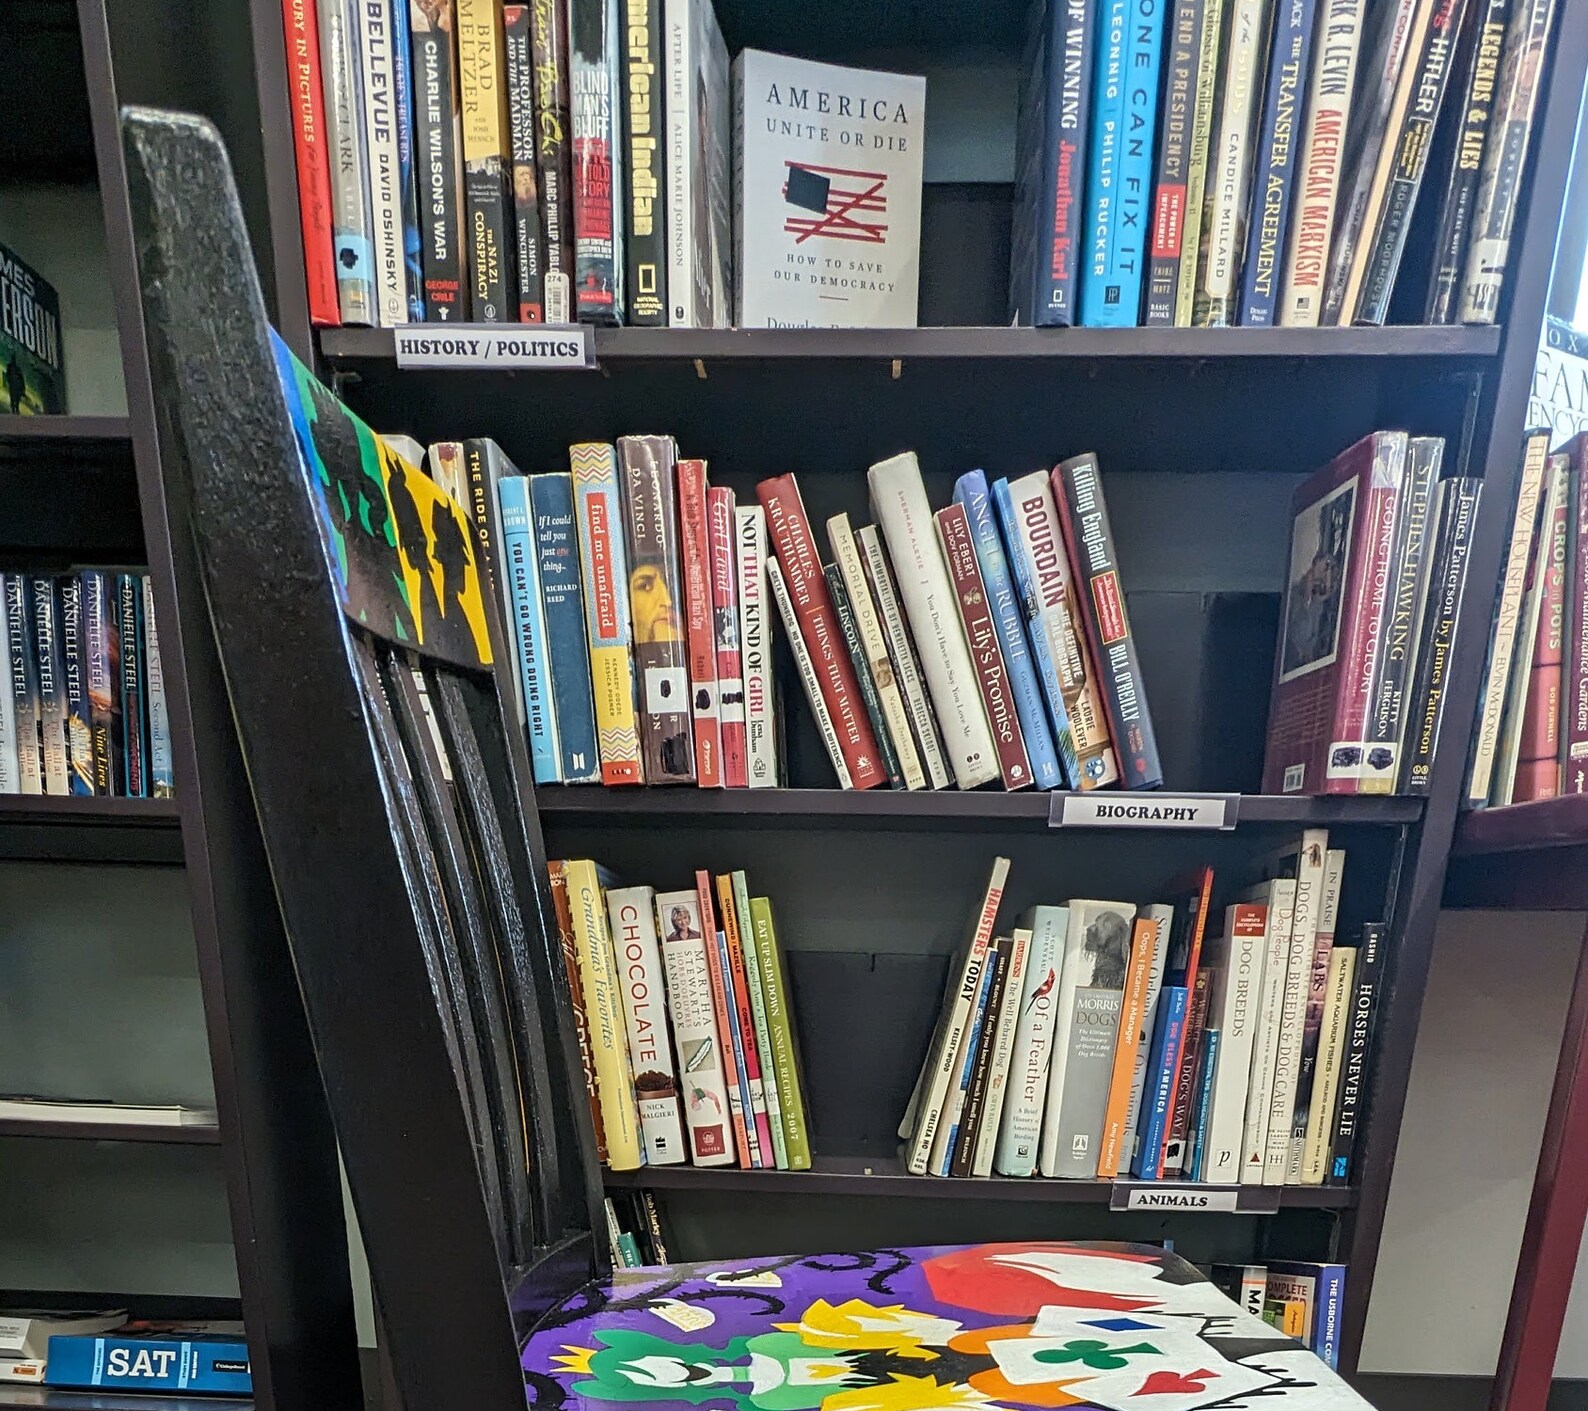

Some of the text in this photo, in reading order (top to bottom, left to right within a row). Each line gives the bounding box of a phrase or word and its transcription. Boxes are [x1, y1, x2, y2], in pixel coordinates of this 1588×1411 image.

[367, 2, 391, 144] BELLEVUE
[459, 0, 479, 114] MELTZER
[477, 24, 493, 91] BRAD
[1061, 28, 1084, 129] WINNING
[1319, 46, 1352, 96] LEVIN
[1415, 38, 1450, 113] HITLER
[296, 39, 315, 143] IN PICTURES
[518, 64, 533, 161] PROFESSOR
[766, 83, 909, 124] AMERICA
[1165, 8, 1195, 178] END PRESIDENCY
[1459, 23, 1504, 170] LEGENDS LIES
[424, 40, 447, 260] CHARLIE WILSON'S WAR
[509, 87, 523, 162] MADMAN
[766, 118, 908, 152] UNITE OR DIE
[1094, 2, 1124, 276] LEONNIG PHILIP RUCKER
[1305, 109, 1343, 199] AMERICAN
[545, 171, 556, 200] MARC
[1119, 88, 1148, 275] CAN FIX IT
[1215, 133, 1239, 278] CANDICE MILLARD
[1254, 61, 1299, 298] TRANSFER AGREEMENT
[379, 154, 398, 291] DAVID OSHINSKY
[1293, 205, 1329, 287] MARXISM
[425, 280, 460, 290] GEORGE
[473, 210, 488, 301] CONSPIRACY
[487, 246, 498, 284] NAZI
[517, 218, 529, 295] WINCHESTER
[527, 237, 537, 276] SIMON
[547, 275, 563, 283] 274
[773, 270, 896, 293] OUR DEMOCRACY
[786, 254, 883, 274] HOW TO SAVE
[1052, 237, 1071, 280] Karl
[400, 339, 579, 357] HISTORY POLITICS
[469, 451, 487, 523] THE RIDE
[634, 490, 646, 539] VINCI
[1072, 463, 1096, 513] Killing
[591, 504, 614, 628] find me unafraid
[767, 496, 811, 606] KRAUTHAMMER
[787, 514, 816, 579] CHARLES
[952, 517, 976, 577] LILY EBERT
[1021, 495, 1066, 609] BOURDAIN
[1081, 512, 1112, 571] England
[1371, 496, 1395, 610] GOING HOME
[1500, 443, 1545, 637] THE NEW HOUSEPLANT
[741, 514, 764, 718] NOT THAT KIND OF GIRL
[840, 534, 864, 606] MEMORIAL
[863, 611, 881, 651] DRIVE
[1390, 562, 1418, 662] HAWKING
[1549, 521, 1567, 650] CROPS POTS
[122, 588, 135, 652] DANIELLE
[512, 542, 544, 737] YOU CAN'T WRONG DOING RIGHT
[838, 603, 861, 653] LINCOLN
[995, 588, 1027, 664] RUBBLE
[1419, 491, 1475, 755] James Patterson by James Patterson
[12, 657, 26, 698] STEEL
[40, 655, 54, 696] STEEL
[67, 664, 81, 705] STEEL
[90, 655, 103, 690] STEEL
[123, 655, 137, 690] STEEL
[812, 614, 861, 745] THINGS THAT MATTER
[971, 616, 1014, 744] Lily's Promise
[1054, 635, 1075, 688] BIOGRAPHY
[1063, 628, 1083, 679] DEFINITIVE
[1109, 643, 1128, 672] BILL
[1490, 657, 1507, 687] ELVIN
[1082, 700, 1096, 732] LAURIE
[1114, 671, 1140, 722] O'REILLY
[1377, 680, 1394, 738] FERGUSON
[921, 727, 936, 754] SKLOOT
[1096, 804, 1199, 821] BIOGRAPHY
[973, 887, 1001, 957] HAMSTERS
[1323, 888, 1336, 926] PRAISE
[620, 905, 658, 1063] CHOCOLATE
[667, 952, 685, 1029] HANDBOOK
[684, 950, 702, 1028] STEWART'S
[694, 950, 712, 1026] MARTHA
[764, 957, 780, 1017] SLIM DOWN
[961, 959, 982, 1002] TODAY
[1077, 998, 1119, 1011] MORRIS
[1232, 941, 1253, 1037] DOG BREEDS
[1271, 881, 1312, 1119] DOGS, DOG BREEDS DOG CARE
[1076, 1012, 1117, 1026] DOGS
[1124, 1008, 1139, 1046] Manager
[1023, 1037, 1046, 1103] Feather
[1156, 1068, 1171, 1113] AMERICA
[1339, 984, 1374, 1137] HORSES NEVER LIE
[1014, 1133, 1035, 1141] Birding
[1104, 1122, 1119, 1169] Amy Newfield
[649, 1208, 660, 1236] Marley
[1137, 1194, 1208, 1207] ANIMALS
[1325, 1299, 1337, 1342] USBORNE
[107, 1348, 176, 1378] SAT
